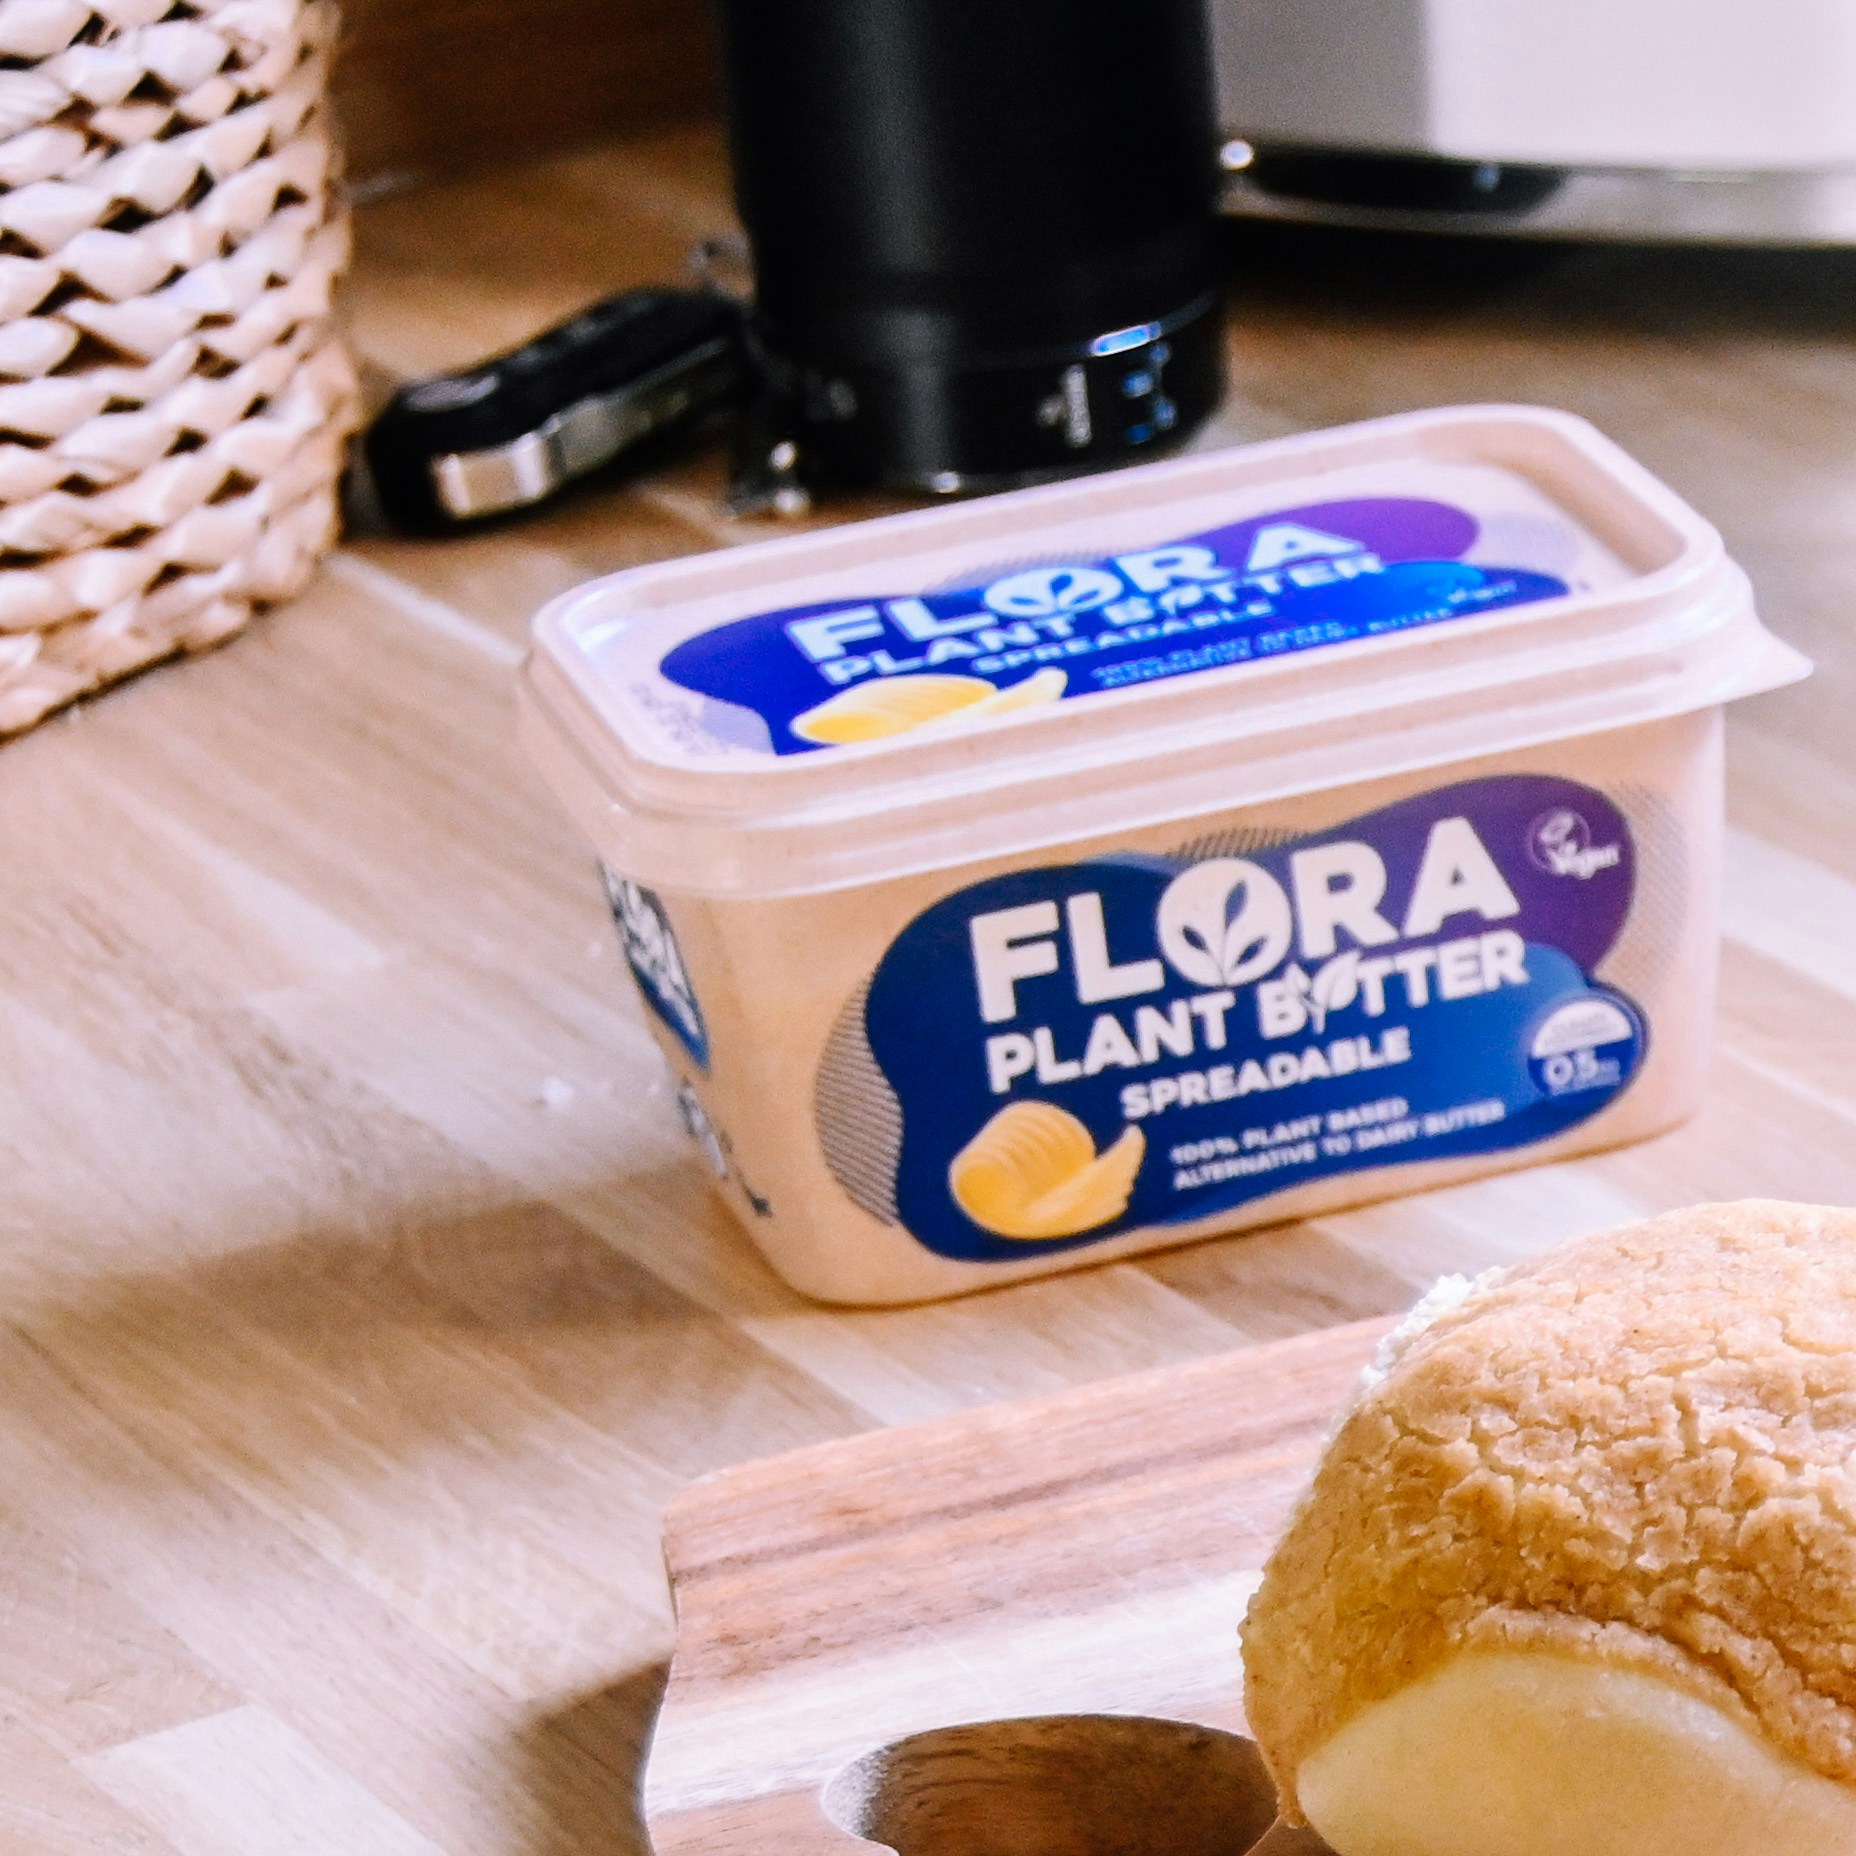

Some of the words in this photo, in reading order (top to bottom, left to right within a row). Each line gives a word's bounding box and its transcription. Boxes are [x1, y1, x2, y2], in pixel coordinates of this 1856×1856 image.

[786, 523, 1363, 662] FLORA
[819, 612, 1077, 685] PLANT
[1102, 553, 1386, 627] BTTER
[971, 600, 1277, 675] SPREADABLE
[968, 816, 1521, 1023] FLORA
[985, 990, 1236, 1094] PLANT
[1257, 929, 1531, 1041] BTTER
[1119, 1026, 1412, 1119] SPREADABLE
